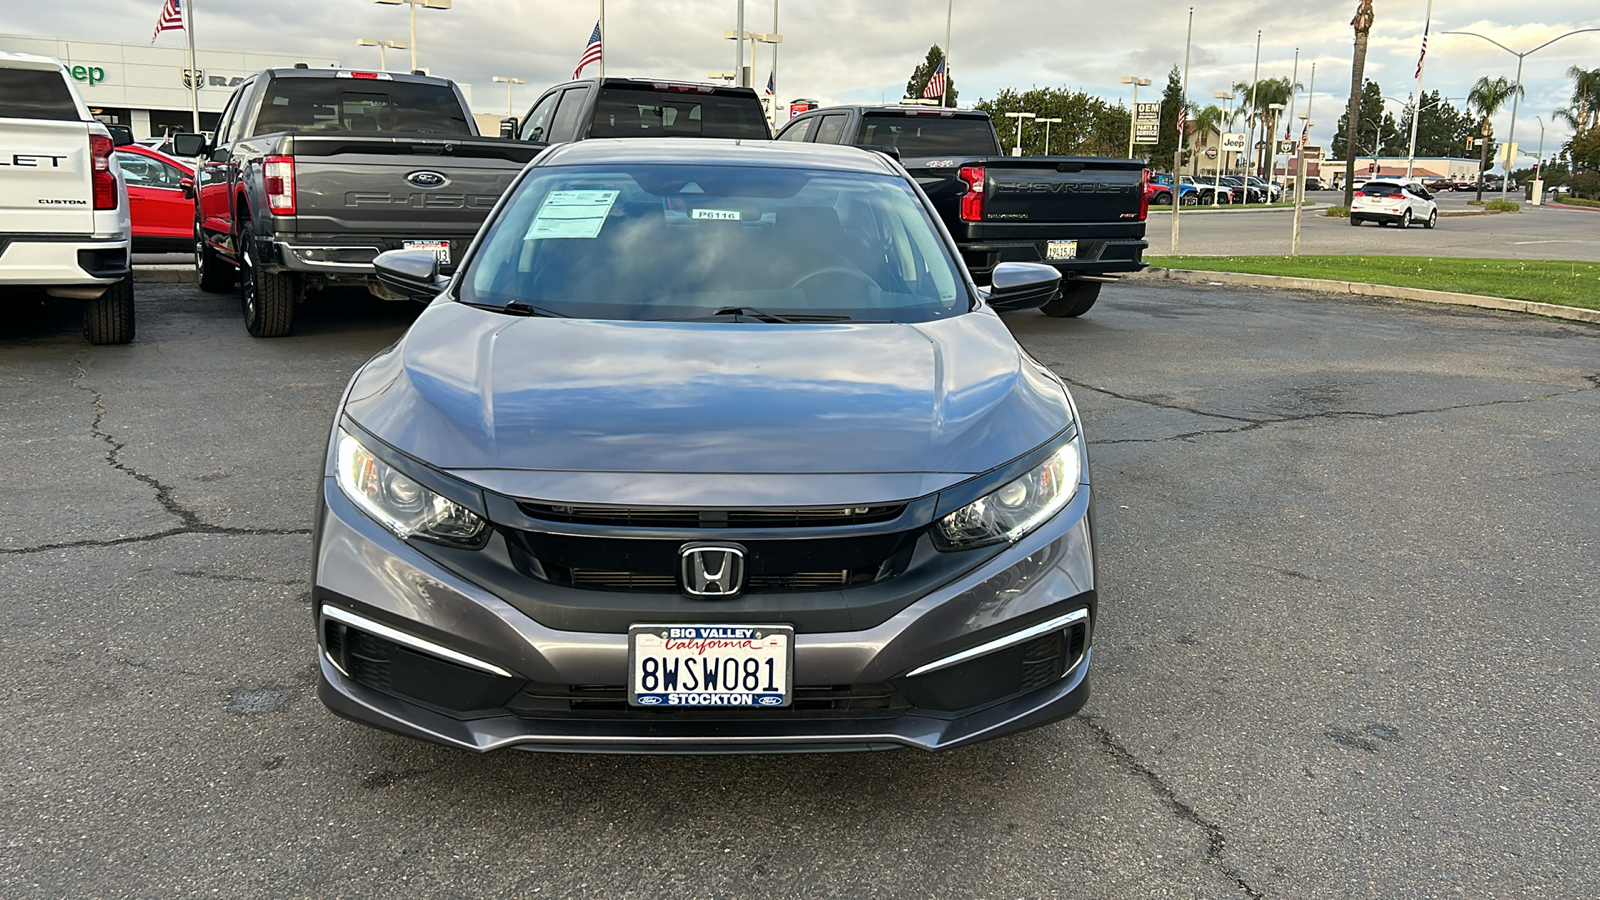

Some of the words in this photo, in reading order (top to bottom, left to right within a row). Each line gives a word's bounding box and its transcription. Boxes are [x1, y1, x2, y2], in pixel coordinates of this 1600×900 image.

[1138, 104, 1159, 113] OEM
[1224, 139, 1245, 148] Jeep
[416, 174, 438, 183] Ford
[999, 183, 1136, 194] CHEVROLET
[698, 211, 736, 219] P6116
[670, 628, 696, 638] BIG
[700, 628, 754, 638] VALLEY
[664, 638, 763, 656] California
[641, 657, 779, 692] 8WSW081
[667, 693, 753, 705] STOCKTON
